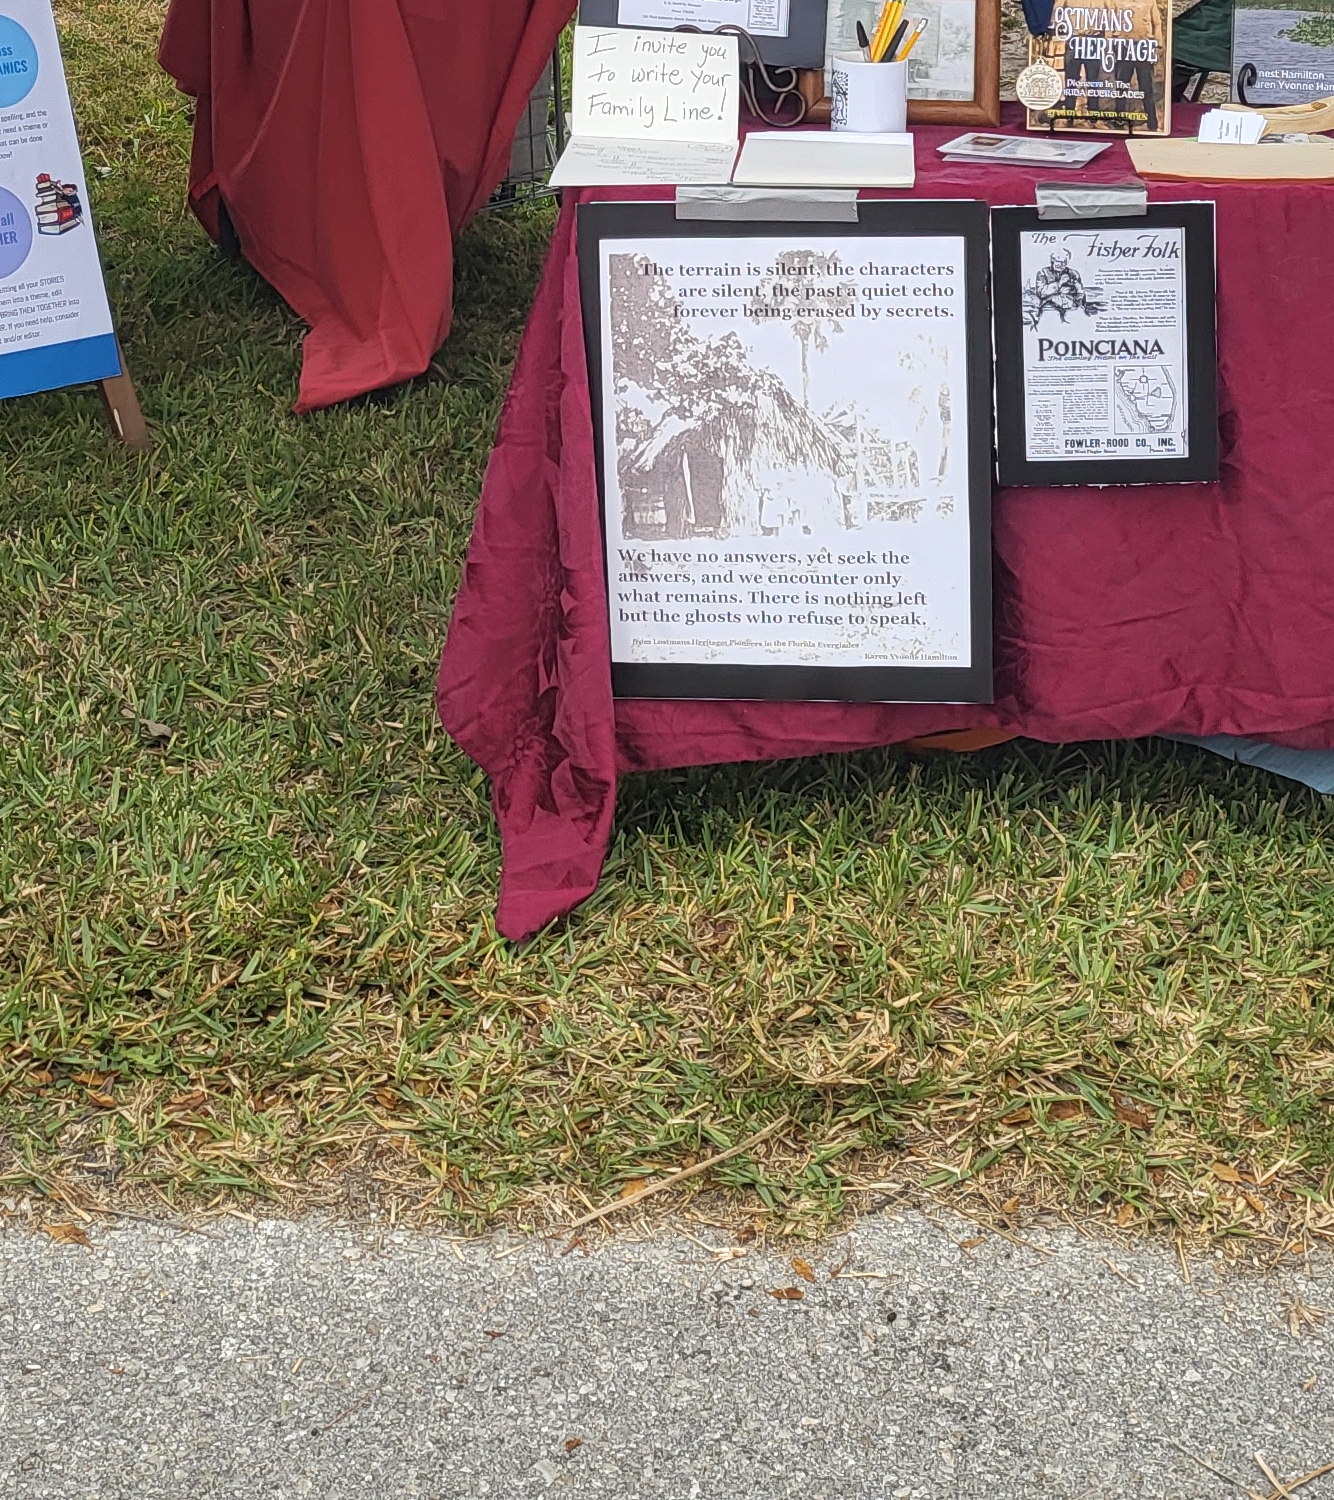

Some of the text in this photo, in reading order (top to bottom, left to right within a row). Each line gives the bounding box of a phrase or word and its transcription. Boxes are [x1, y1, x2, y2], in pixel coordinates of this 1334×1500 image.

[587, 32, 727, 68] I invite you
[588, 63, 683, 85] to write
[1282, 70, 1324, 79] Hamilton
[1278, 81, 1314, 90] Yvonne
[588, 88, 727, 129] Family Line!
[0, 213, 15, 227] all
[1031, 233, 1179, 263] The Fisher Folk
[640, 262, 954, 279] The terrain is silent, the characters
[678, 284, 954, 301] are silent, the past a quiet echo
[673, 304, 954, 321] forever being erased by secrets.
[1037, 338, 1165, 361] POINCIANA
[1065, 439, 1129, 448] FOWLER-ROOD
[1158, 438, 1176, 446] INC.
